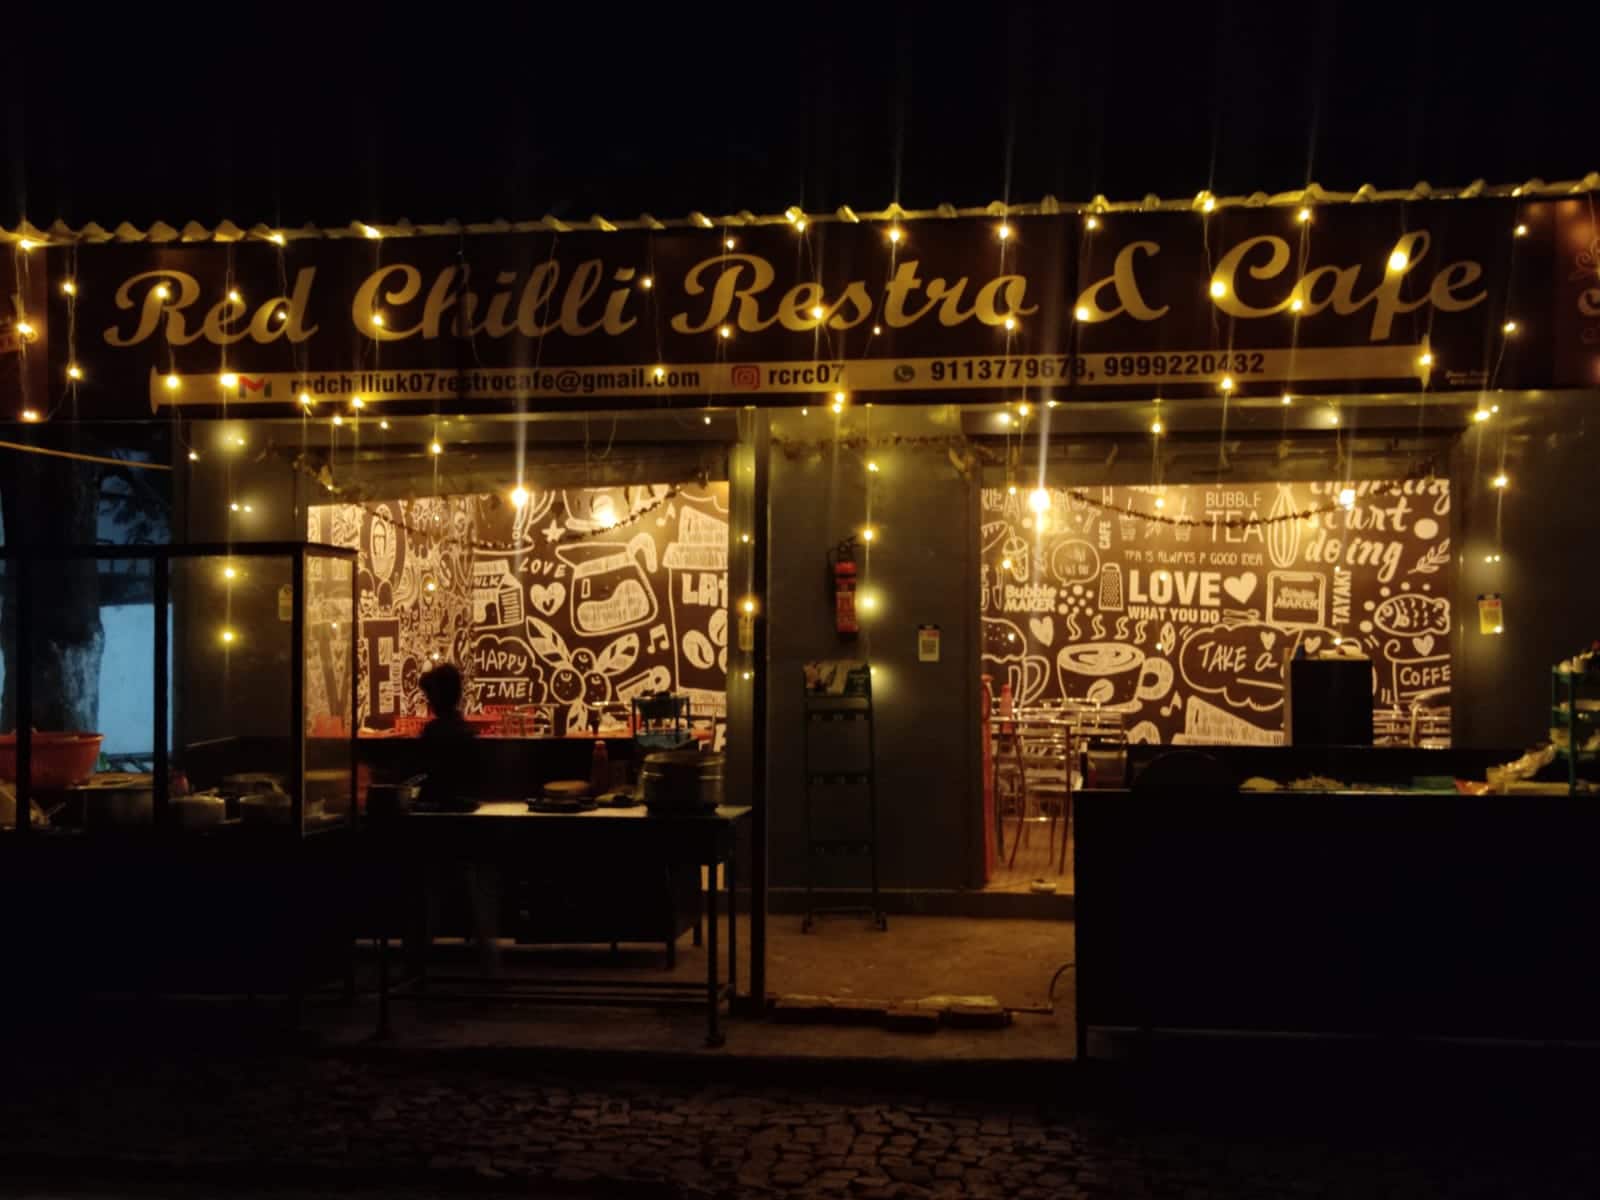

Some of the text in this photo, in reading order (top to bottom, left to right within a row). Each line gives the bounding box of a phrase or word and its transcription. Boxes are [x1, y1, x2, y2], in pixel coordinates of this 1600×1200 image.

[104, 267, 318, 348] Red
[351, 257, 638, 340] Chilli
[671, 253, 1038, 335] Restro
[1073, 240, 1170, 323] &
[1212, 230, 1488, 341] Cafe
[768, 362, 845, 385] rcrc07
[1103, 353, 1265, 377] 9999220432
[1205, 490, 1263, 509] BUBBLE
[1204, 509, 1265, 543] TEA
[519, 557, 567, 578] LOVE
[1304, 527, 1404, 583] doing
[1128, 568, 1222, 607] LOVE
[1127, 604, 1220, 624] WHAT YOU DO
[473, 649, 528, 675] HAPPY
[1198, 641, 1248, 673] TAKE
[474, 681, 534, 703] TIME!
